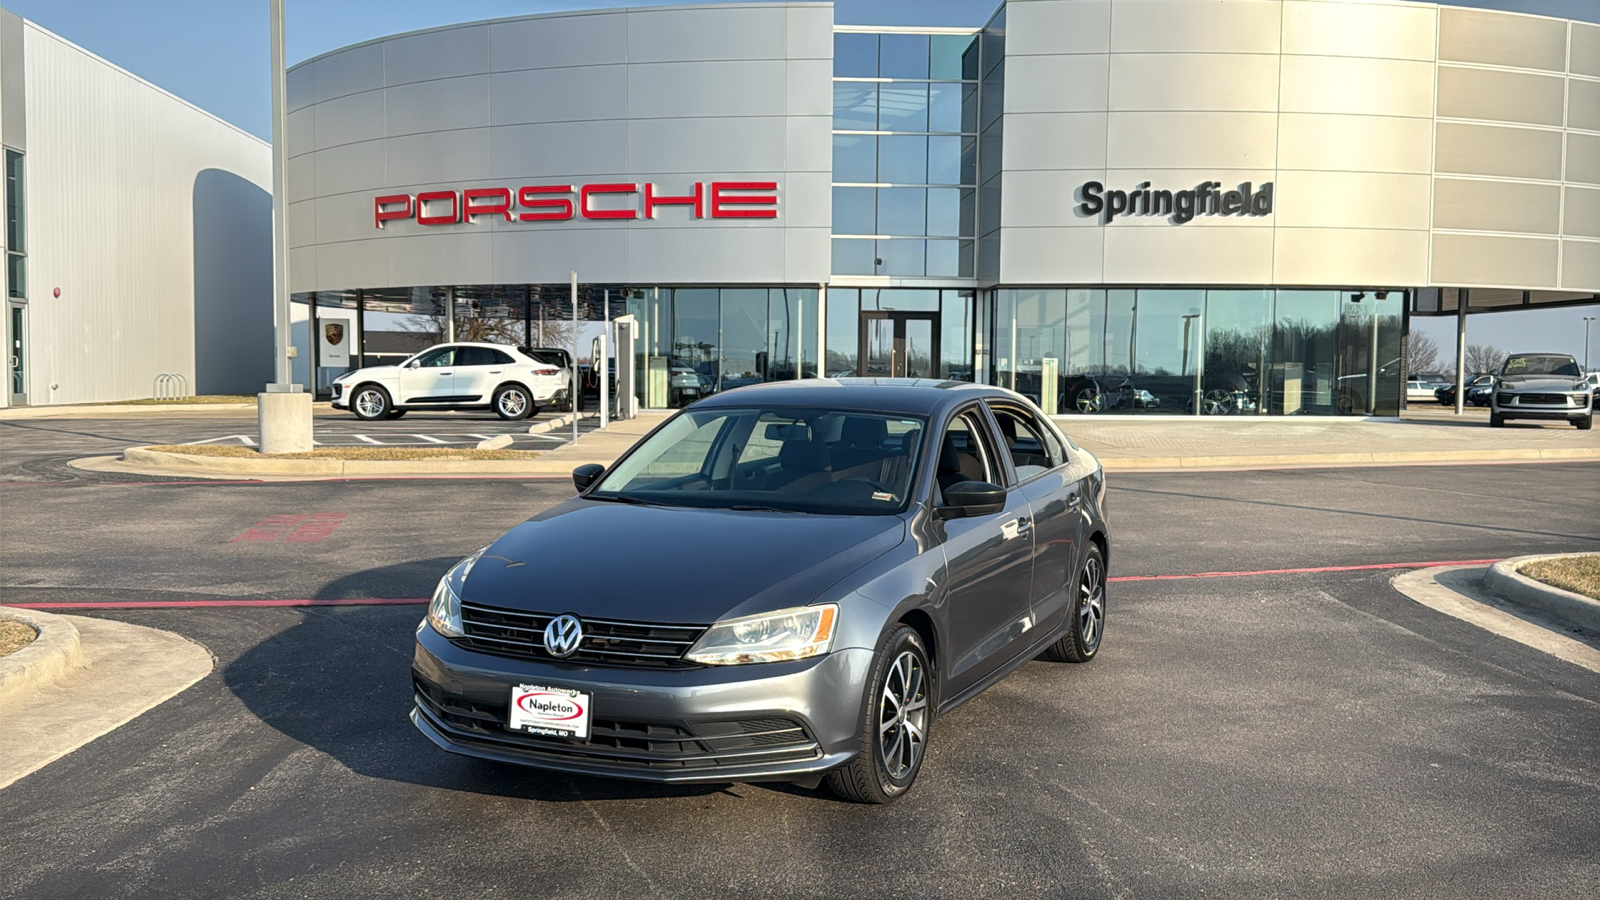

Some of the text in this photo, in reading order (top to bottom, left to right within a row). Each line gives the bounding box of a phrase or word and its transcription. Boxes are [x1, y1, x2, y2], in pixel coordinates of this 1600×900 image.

[374, 181, 778, 229] PORSCHE
[1080, 180, 1274, 225] Springfield
[529, 698, 572, 712] Napleton
